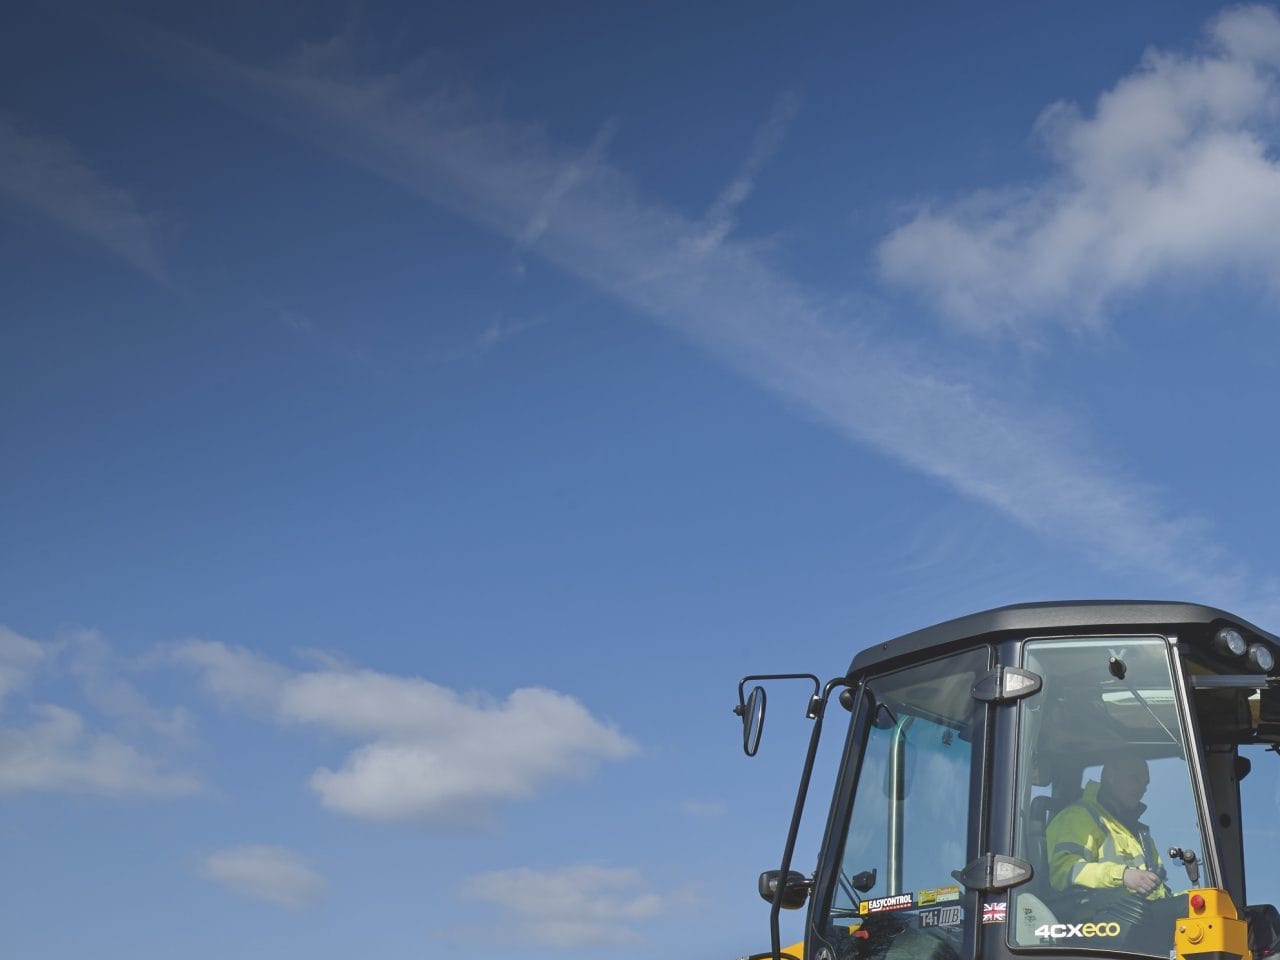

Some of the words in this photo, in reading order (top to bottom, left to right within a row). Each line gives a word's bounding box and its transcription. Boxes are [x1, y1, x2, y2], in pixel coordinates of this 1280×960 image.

[868, 894, 912, 911] EASYCONTROL
[920, 911, 938, 927] T4i
[1034, 921, 1121, 939] 4CXeco
